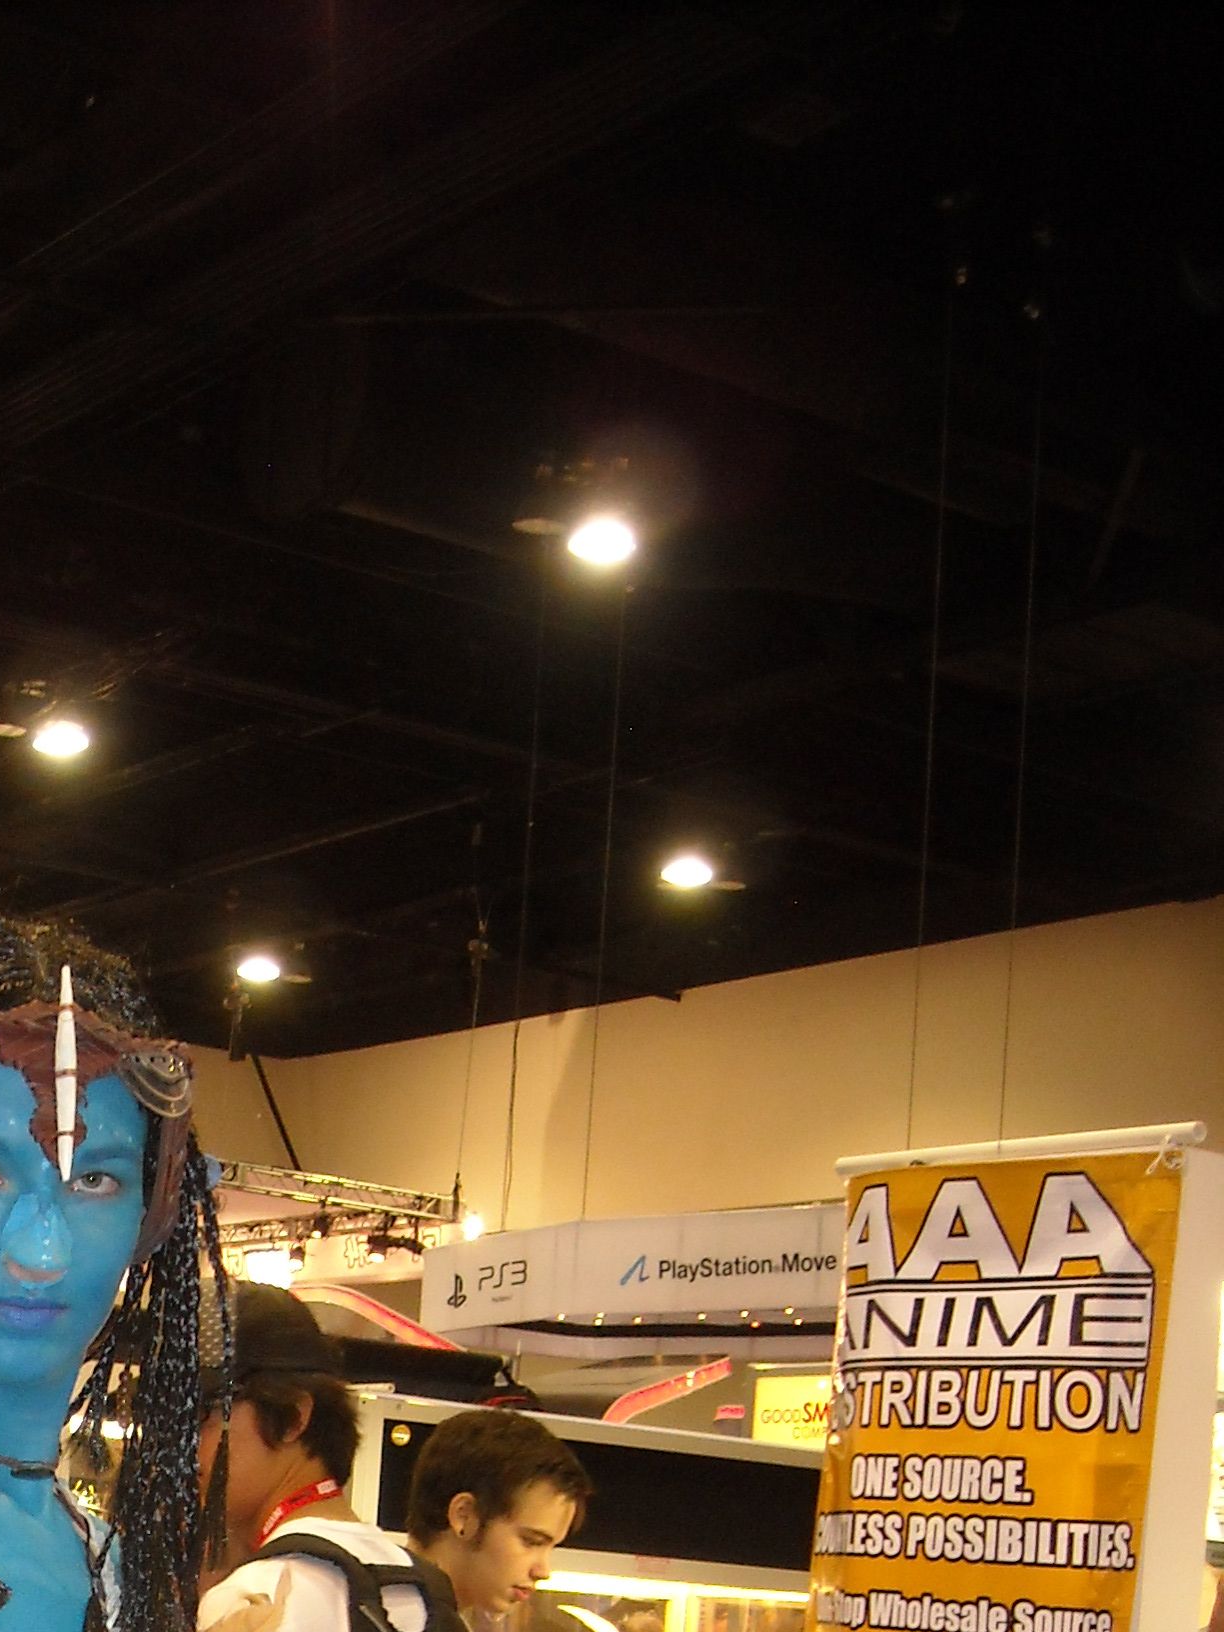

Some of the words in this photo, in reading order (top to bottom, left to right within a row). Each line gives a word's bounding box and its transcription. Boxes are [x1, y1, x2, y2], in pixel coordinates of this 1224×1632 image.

[846, 1172, 1154, 1284] AAA
[478, 1259, 527, 1291] PS3
[658, 1256, 773, 1283] PlayStation
[781, 1253, 838, 1273] Move
[761, 1409, 801, 1424] GOOD
[851, 1454, 900, 1499] ONE
[902, 1454, 1034, 1504] SOURCE.
[905, 1512, 1135, 1570] POSSIBILITIES.
